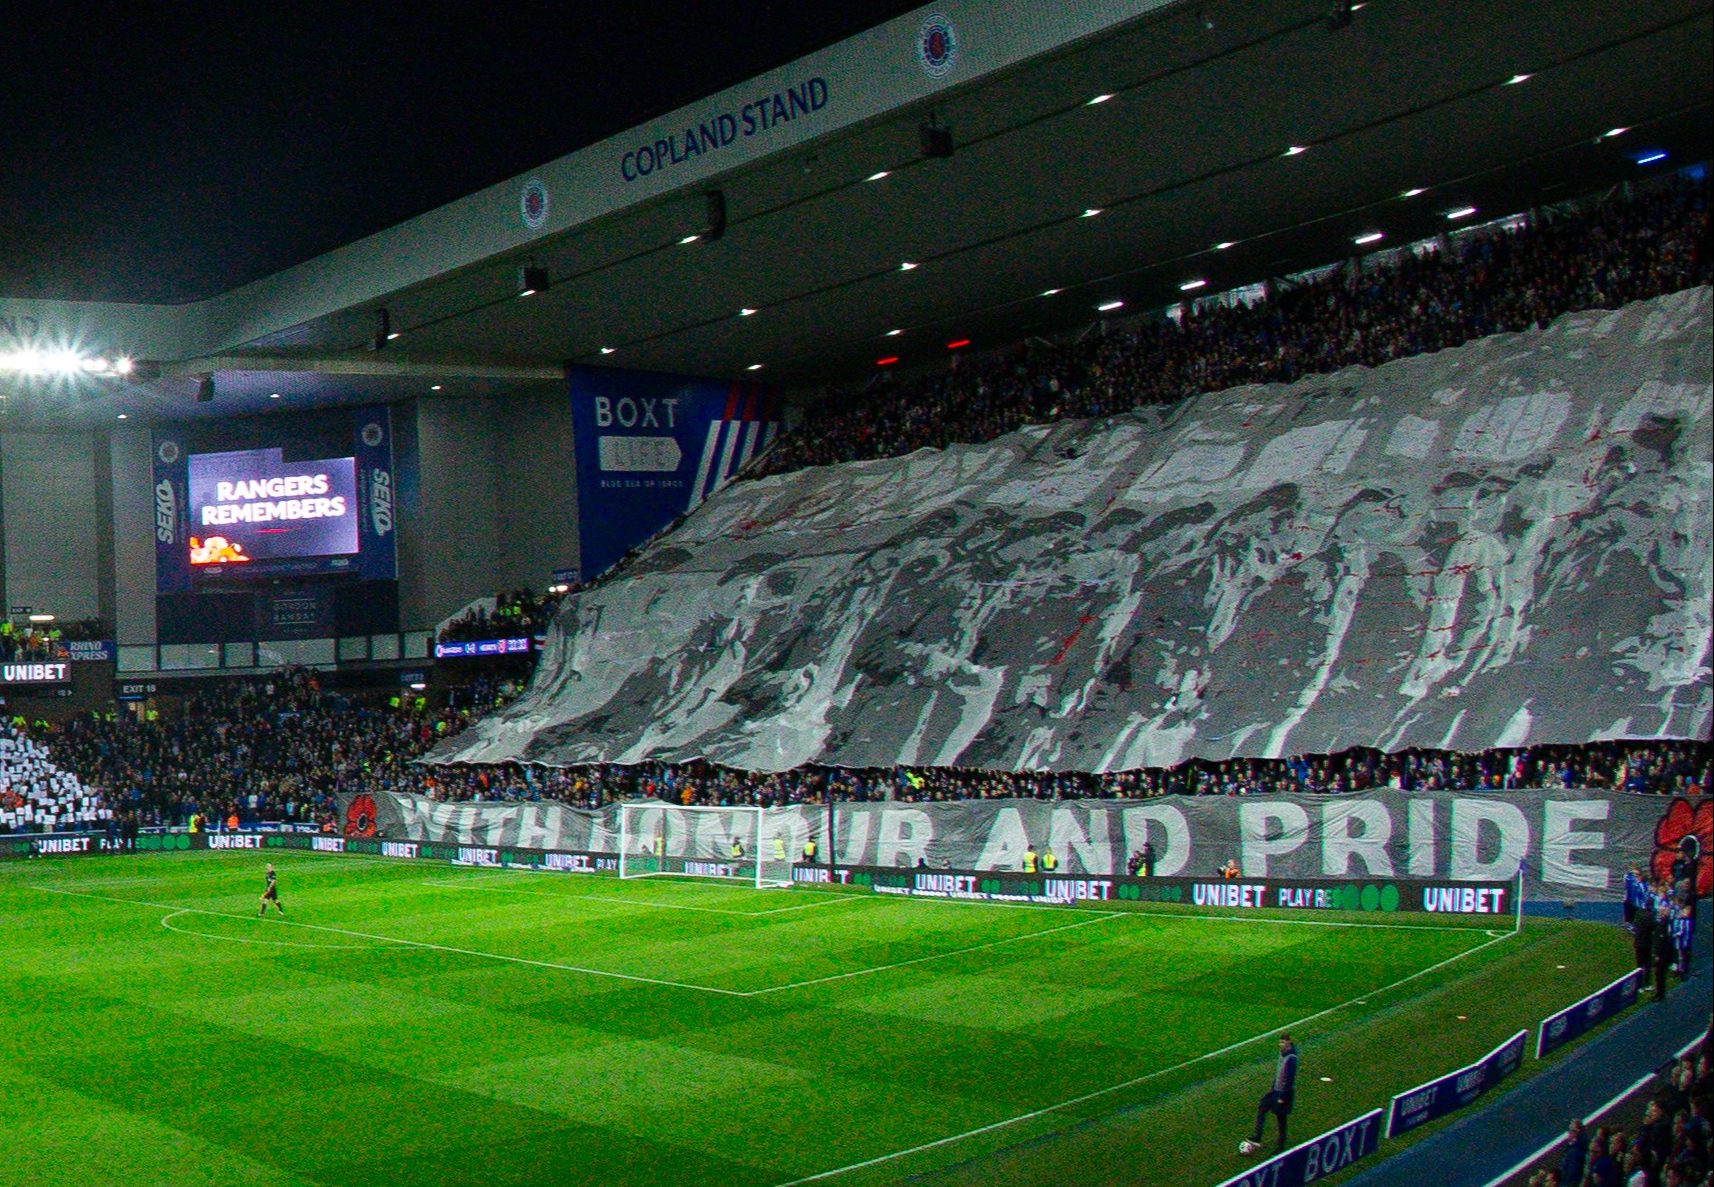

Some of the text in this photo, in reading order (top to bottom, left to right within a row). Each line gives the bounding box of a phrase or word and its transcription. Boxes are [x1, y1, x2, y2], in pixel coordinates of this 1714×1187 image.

[620, 77, 829, 182] COPLAND STAND
[594, 396, 680, 428] BOXT
[216, 473, 330, 502] RANGERS
[155, 478, 176, 545] SEKO
[201, 496, 347, 526] REMEMBERS
[370, 467, 393, 537] SEKO
[69, 641, 102, 651] RHINO
[69, 651, 109, 661] XPRESS
[3, 663, 67, 682] UNIBET
[123, 685, 144, 693] EXIT
[208, 834, 264, 849] UNIBET
[311, 836, 345, 852] UNIBET
[381, 841, 418, 858] UNIBET
[393, 795, 563, 850] WITH
[975, 804, 1192, 878] AND
[1239, 798, 1613, 891] PRIDE
[458, 847, 498, 864] UNIBET
[544, 853, 589, 870] UNIBET
[792, 867, 850, 885] UNIBT
[914, 873, 977, 893] UNIBET
[1044, 879, 1113, 901] UNIBET
[1192, 883, 1267, 908] UNIBET
[1278, 887, 1313, 907] PLAY
[1423, 887, 1506, 913] UNIBET
[1303, 1118, 1372, 1184] BOXT
